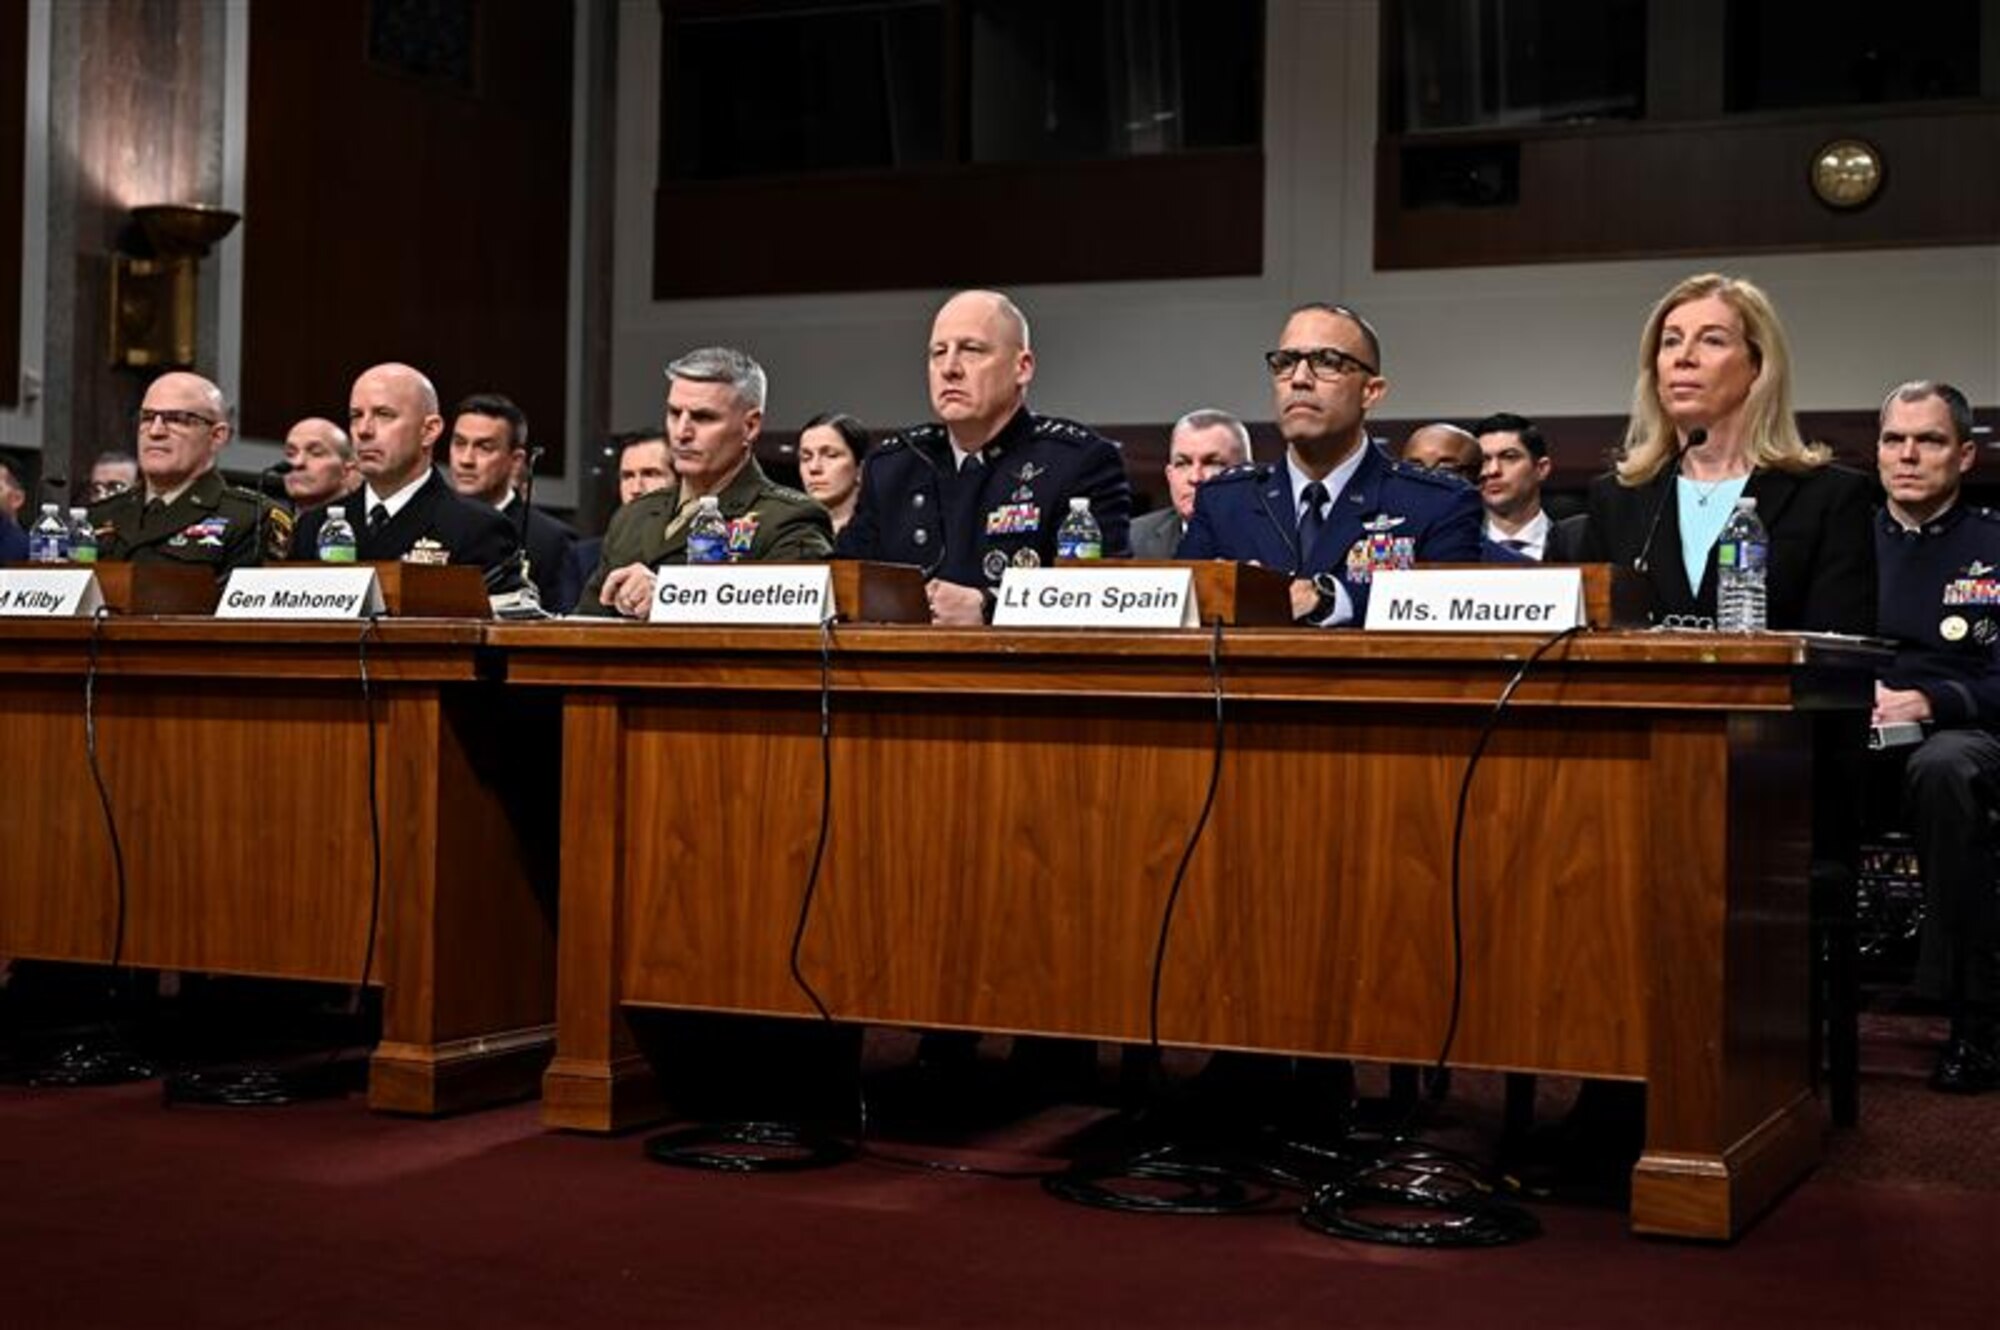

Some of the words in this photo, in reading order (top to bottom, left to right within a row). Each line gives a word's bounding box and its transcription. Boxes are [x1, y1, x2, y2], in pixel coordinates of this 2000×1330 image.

[13, 590, 66, 613] Kilby
[227, 590, 266, 608] Gen
[270, 590, 359, 613] Mahoney
[658, 584, 707, 605] Gen
[716, 583, 819, 605] Guetlein
[1004, 587, 1030, 608] Lt
[1039, 587, 1091, 608] Gen
[1101, 586, 1179, 613] Spain
[1388, 598, 1438, 621] Ms.
[1449, 598, 1556, 622] Maurer
